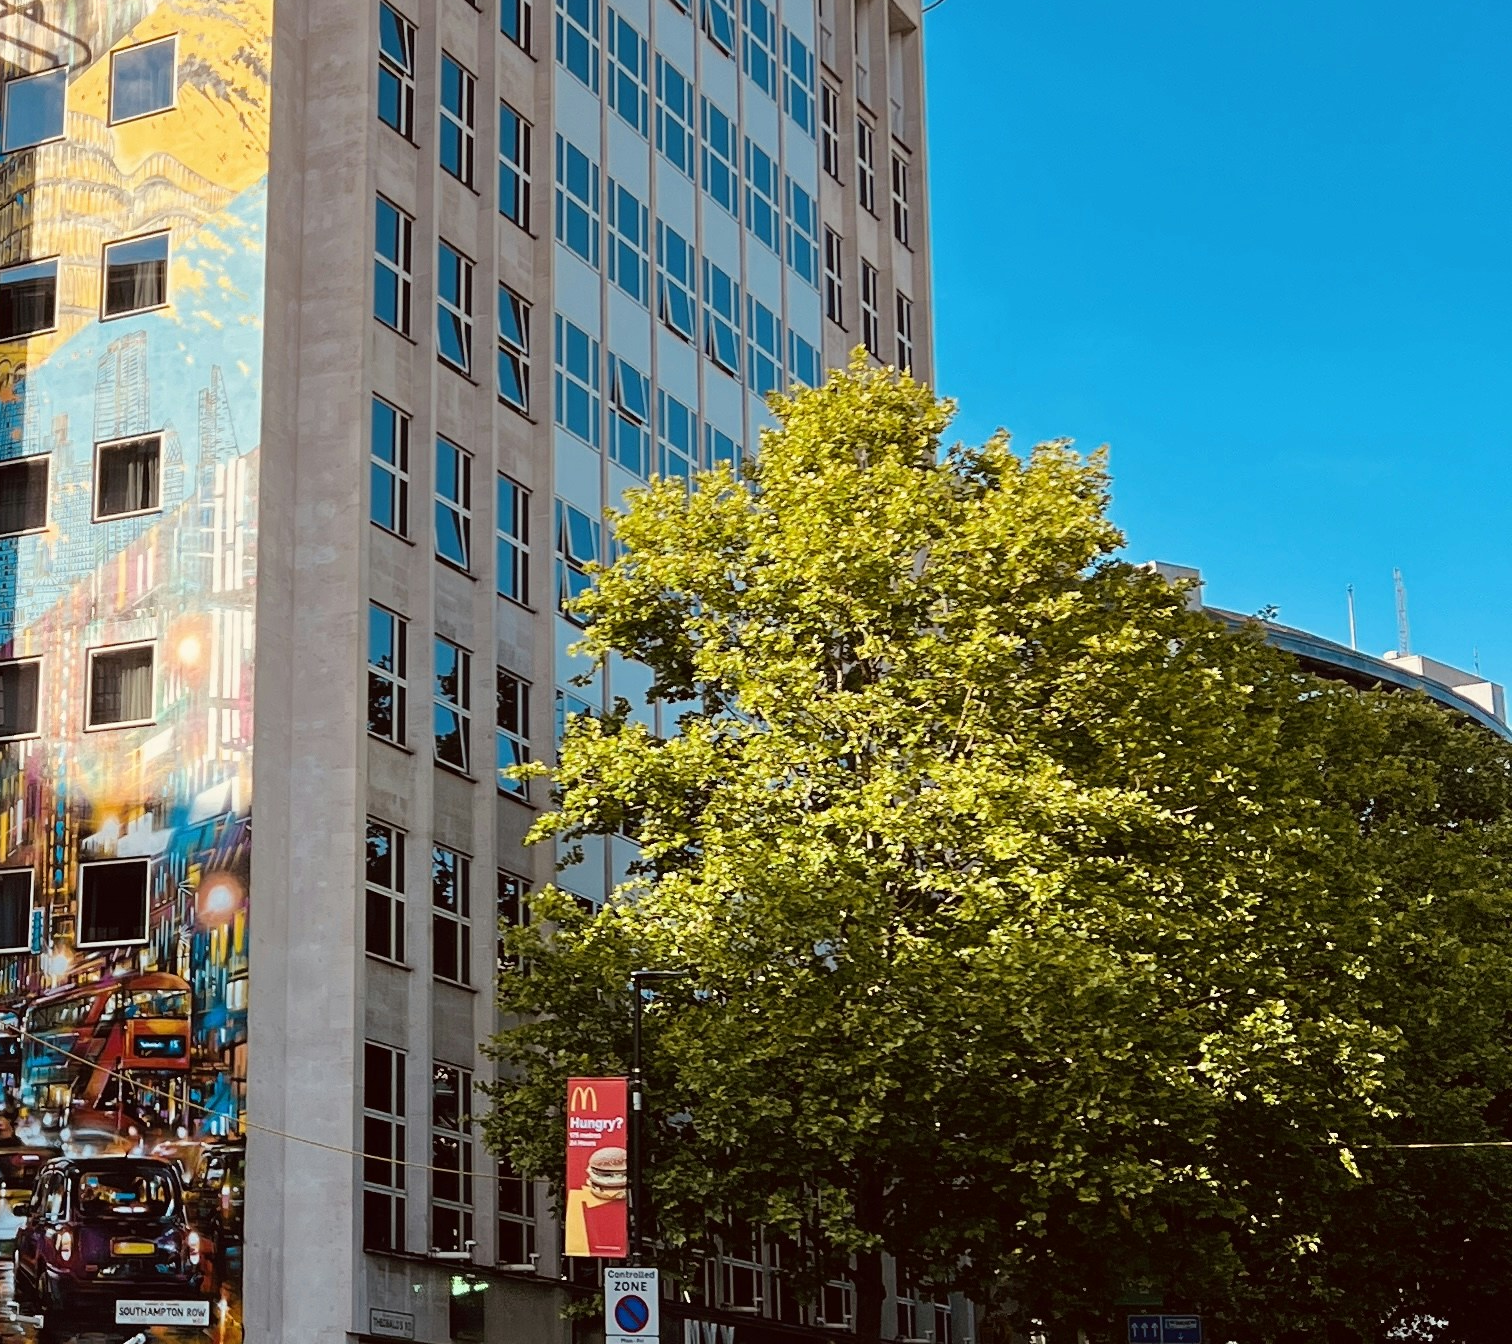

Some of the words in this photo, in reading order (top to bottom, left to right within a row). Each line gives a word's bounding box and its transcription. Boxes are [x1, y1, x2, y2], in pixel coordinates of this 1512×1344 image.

[569, 1116, 624, 1133] Hungry?
[607, 1269, 655, 1279] Controlled
[614, 1281, 648, 1292] ZONE
[118, 1306, 184, 1317] SOUTHAMPTON
[186, 1307, 207, 1318] ROW
